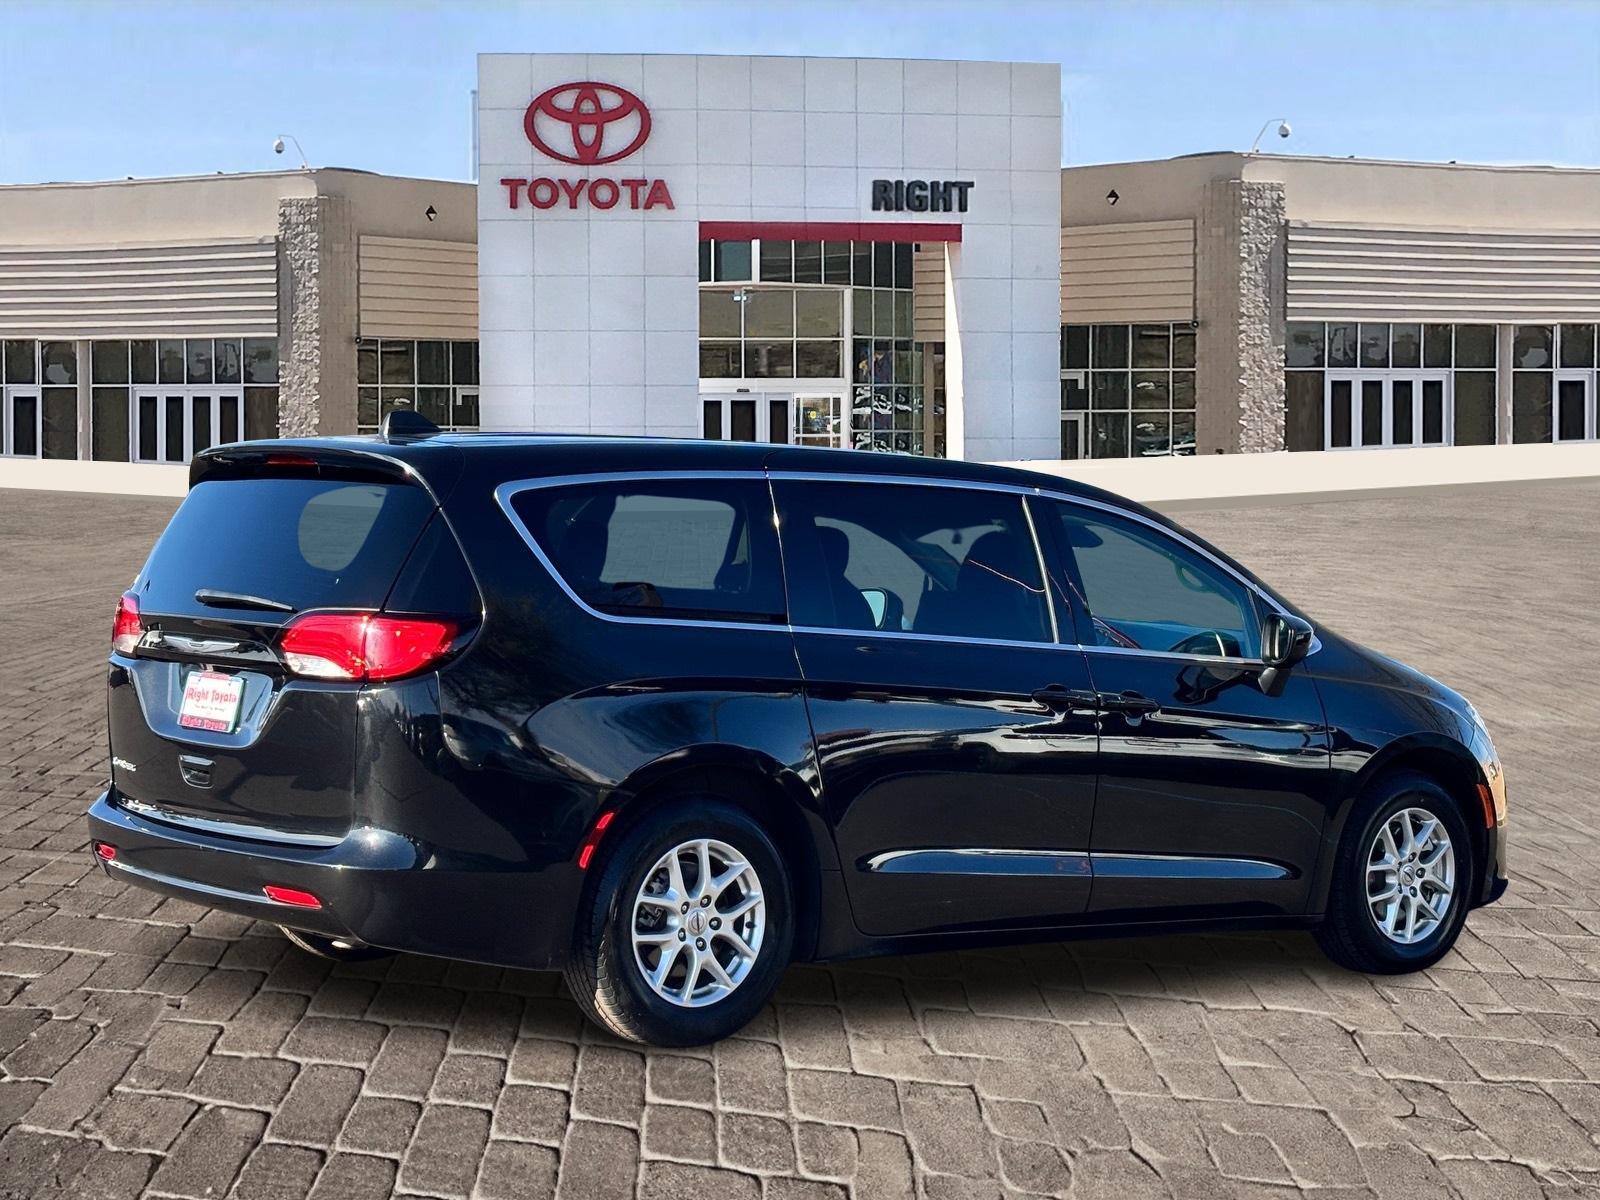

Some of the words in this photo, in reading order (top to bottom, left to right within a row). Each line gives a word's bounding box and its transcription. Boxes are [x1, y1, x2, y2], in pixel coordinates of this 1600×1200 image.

[501, 178, 675, 210] TOYOTA
[872, 179, 975, 212] RIGHT
[187, 687, 209, 702] Right
[211, 689, 237, 703] Toyota
